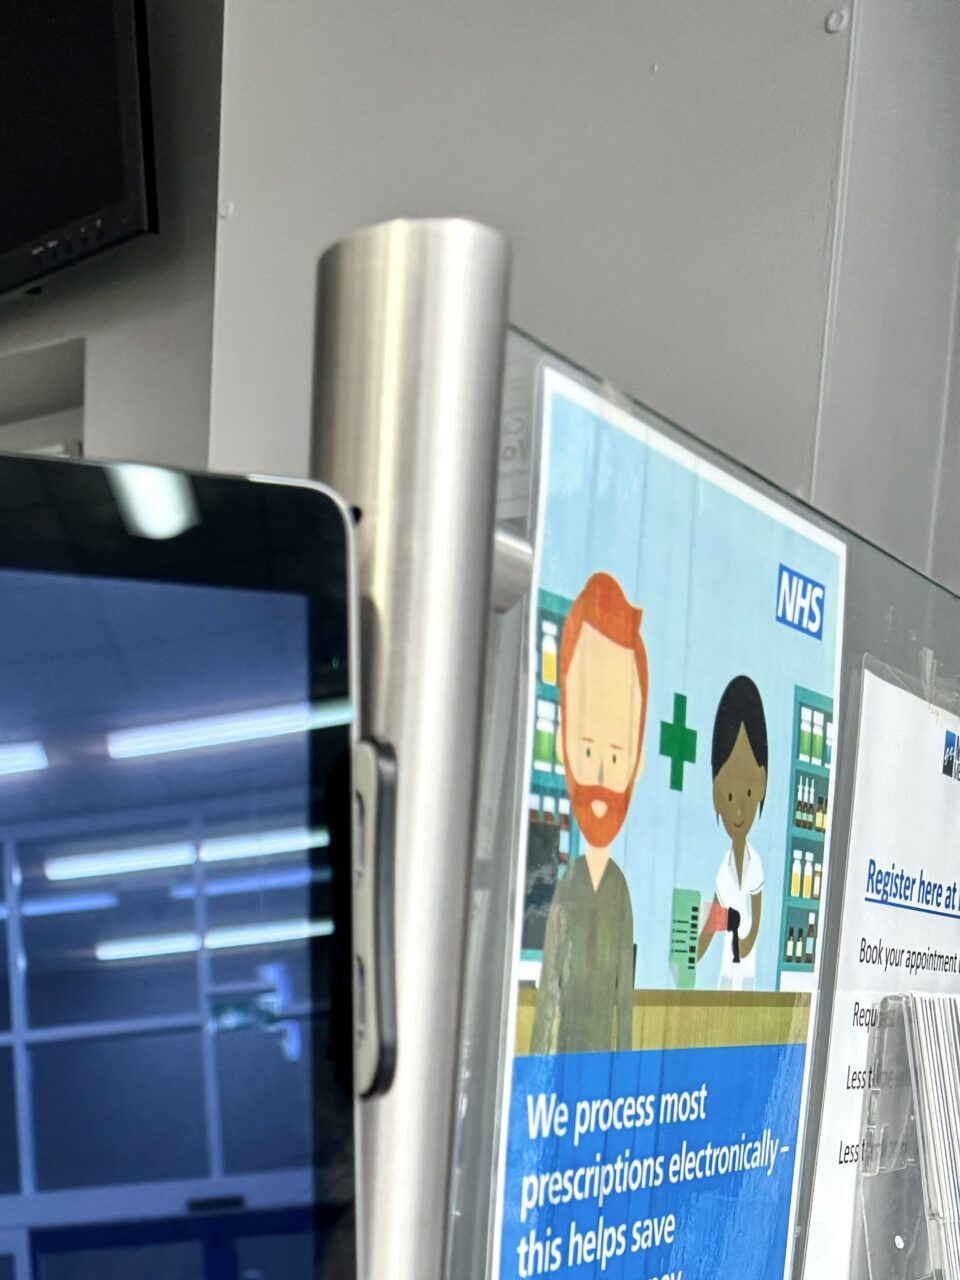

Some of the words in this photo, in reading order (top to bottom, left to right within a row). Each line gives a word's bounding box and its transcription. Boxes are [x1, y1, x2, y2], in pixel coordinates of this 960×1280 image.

[777, 569, 824, 634] NHS
[866, 858, 916, 902] Register
[917, 869, 943, 908] here
[945, 881, 957, 910] at
[859, 937, 883, 965] Book
[885, 946, 905, 972] your
[905, 946, 958, 975] appointment
[852, 1001, 888, 1034] Requ
[846, 1065, 867, 1090] Less
[527, 1092, 568, 1140] We
[574, 1092, 655, 1146] process
[659, 1083, 707, 1123] most
[838, 1139, 858, 1165] Less
[519, 1148, 664, 1223] prescriptions
[516, 1227, 561, 1279] this
[567, 1217, 626, 1270] helps
[631, 1213, 676, 1251] save
